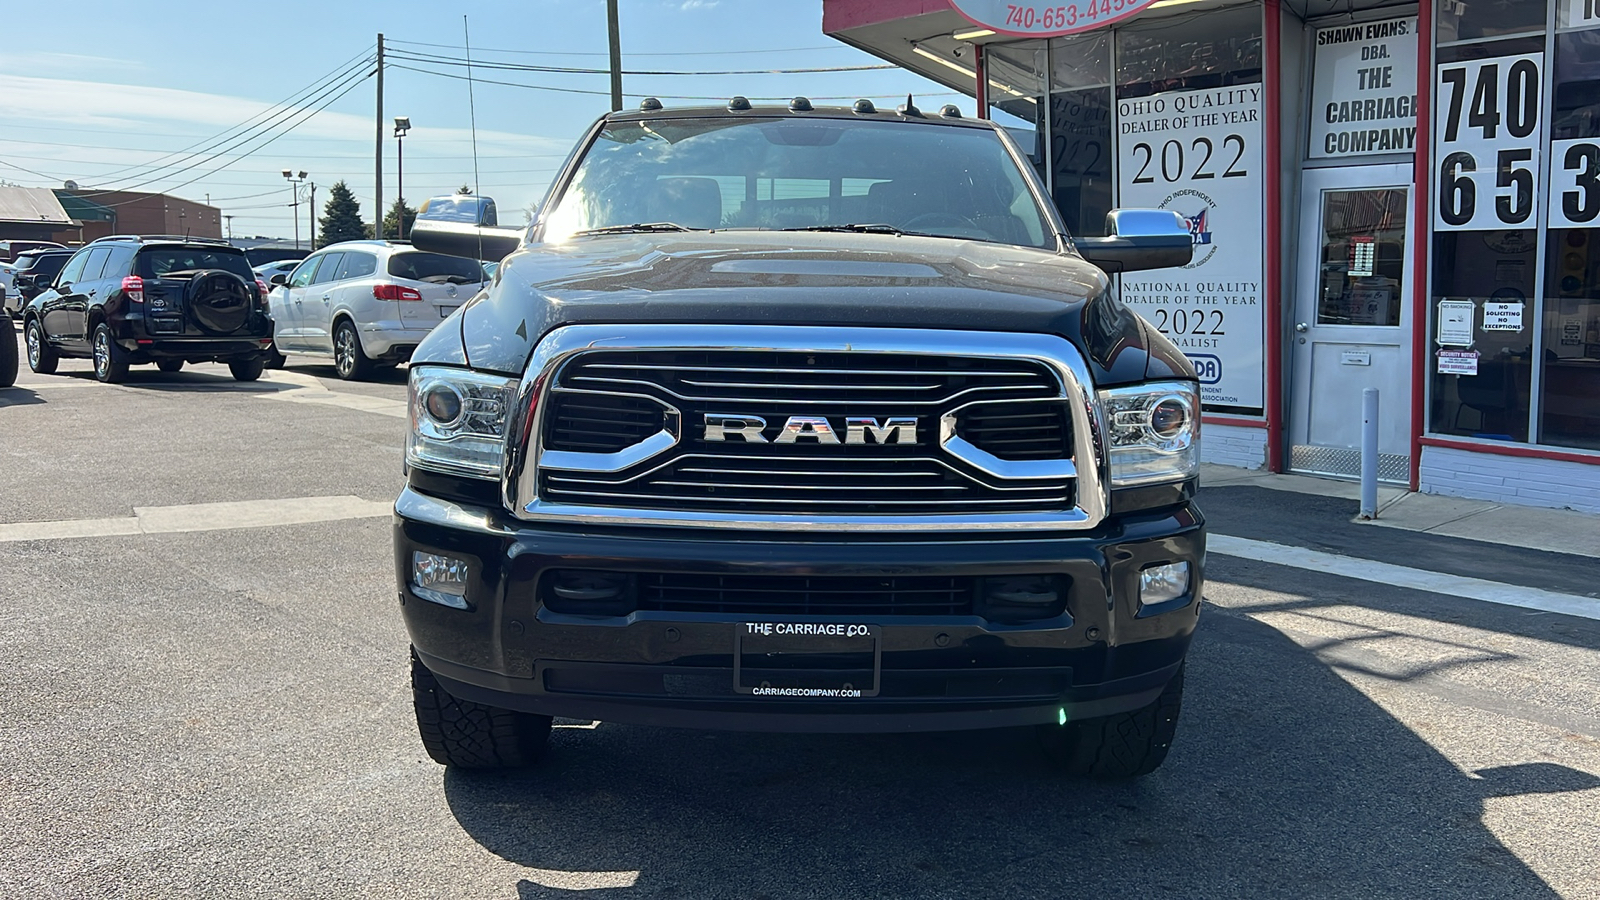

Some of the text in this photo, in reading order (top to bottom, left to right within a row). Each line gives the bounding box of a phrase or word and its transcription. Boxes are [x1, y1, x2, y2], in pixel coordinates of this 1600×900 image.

[1318, 26, 1363, 46] SHAWN
[1361, 44, 1390, 61] DBA.
[1357, 66, 1392, 90] THE
[1119, 99, 1165, 117] OHIO
[1174, 87, 1260, 113] QUALITY
[1442, 59, 1539, 142] 740
[1121, 118, 1169, 134] DEALER
[1172, 116, 1189, 129] OF
[1192, 113, 1218, 127] THE
[1222, 109, 1257, 124] YEAR
[1325, 126, 1417, 154] COMPANY
[1132, 134, 1247, 184] 2022
[1172, 189, 1217, 209] INDEPENDENT
[1123, 282, 1258, 294] NATIONAL QUALITY
[1125, 295, 1256, 305] DEALER OF THE YEAR
[1155, 309, 1225, 335] 2022
[1201, 395, 1238, 403] ASSOCIATION
[703, 413, 918, 444] RAM
[746, 622, 871, 636] THE CARRIAGE CO.
[752, 687, 861, 697] CARRIAGECOMPANY.COM
